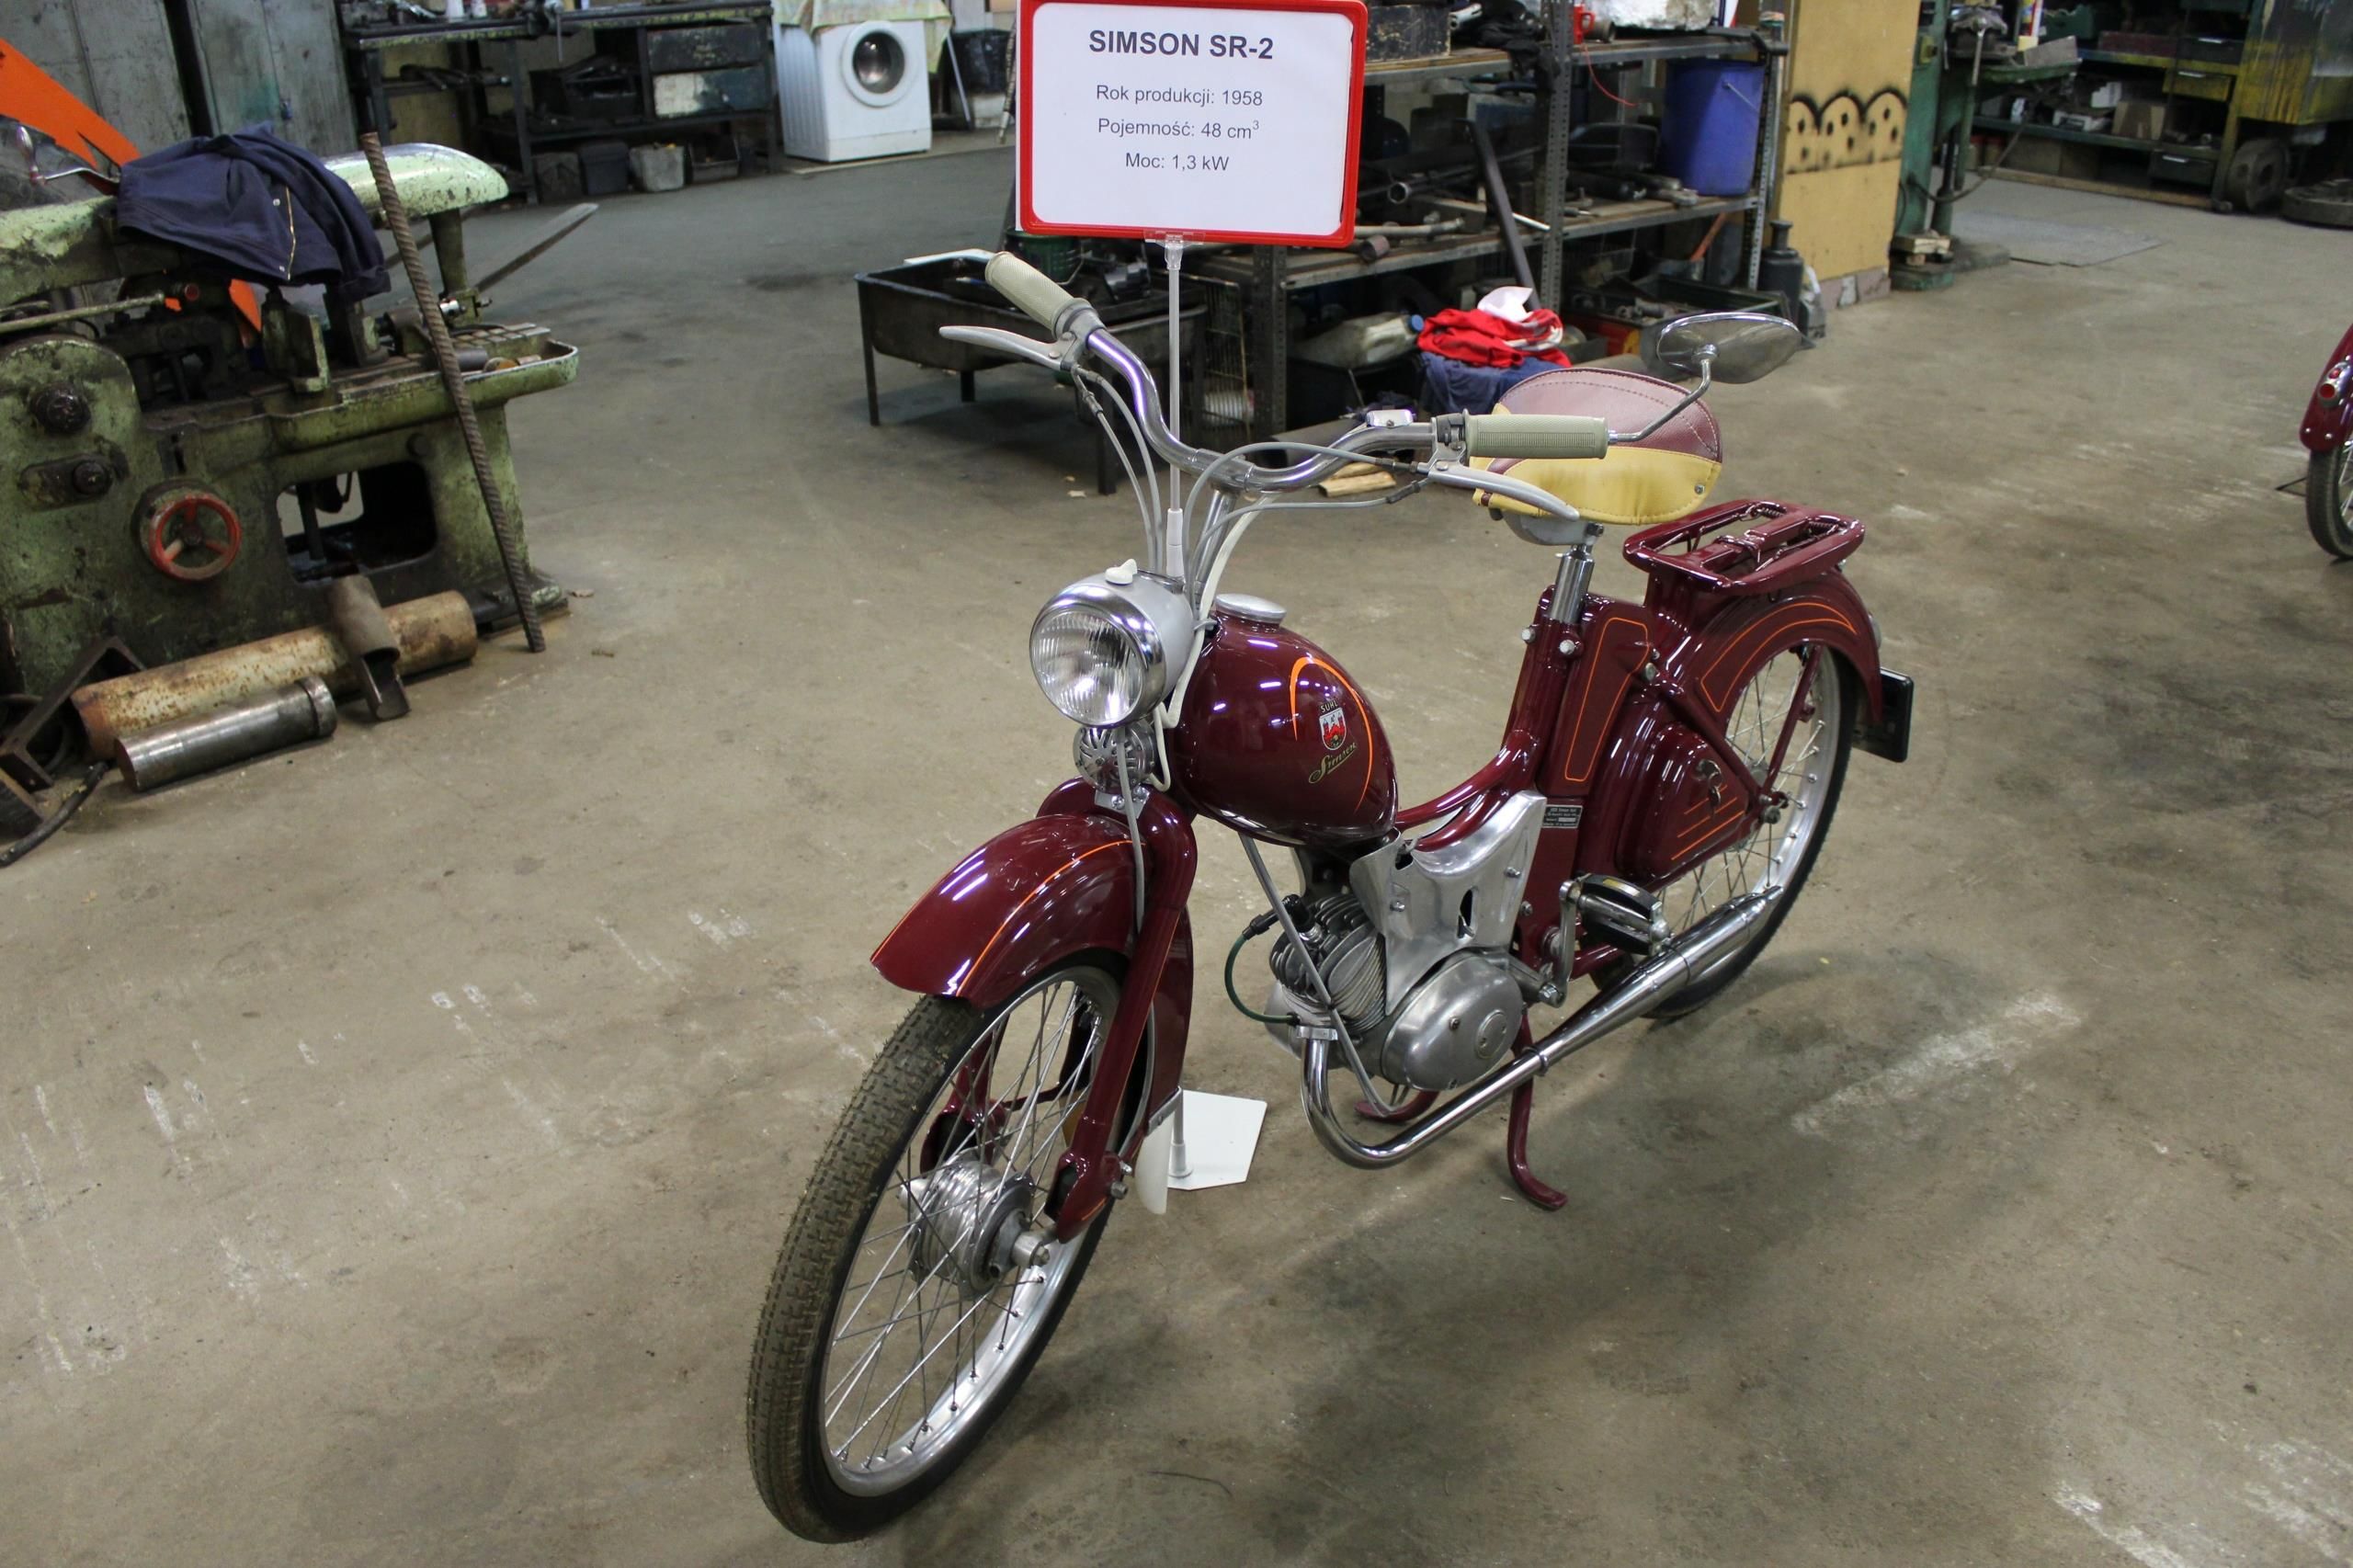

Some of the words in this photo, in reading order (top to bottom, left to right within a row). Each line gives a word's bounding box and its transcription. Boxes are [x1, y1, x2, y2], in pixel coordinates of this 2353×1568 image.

[1088, 29, 1199, 57] SIMSON
[1209, 34, 1274, 60] SR-2
[1097, 85, 1130, 101] Rok
[1135, 87, 1215, 108] produkcji:
[1222, 90, 1263, 107] 1958
[1098, 118, 1195, 138] Pojemność:
[1200, 122, 1222, 139] 48
[1125, 152, 1165, 169] Moc:
[1172, 154, 1197, 172] 1,3
[1202, 156, 1230, 171] kW
[1320, 699, 1339, 713] SUHL
